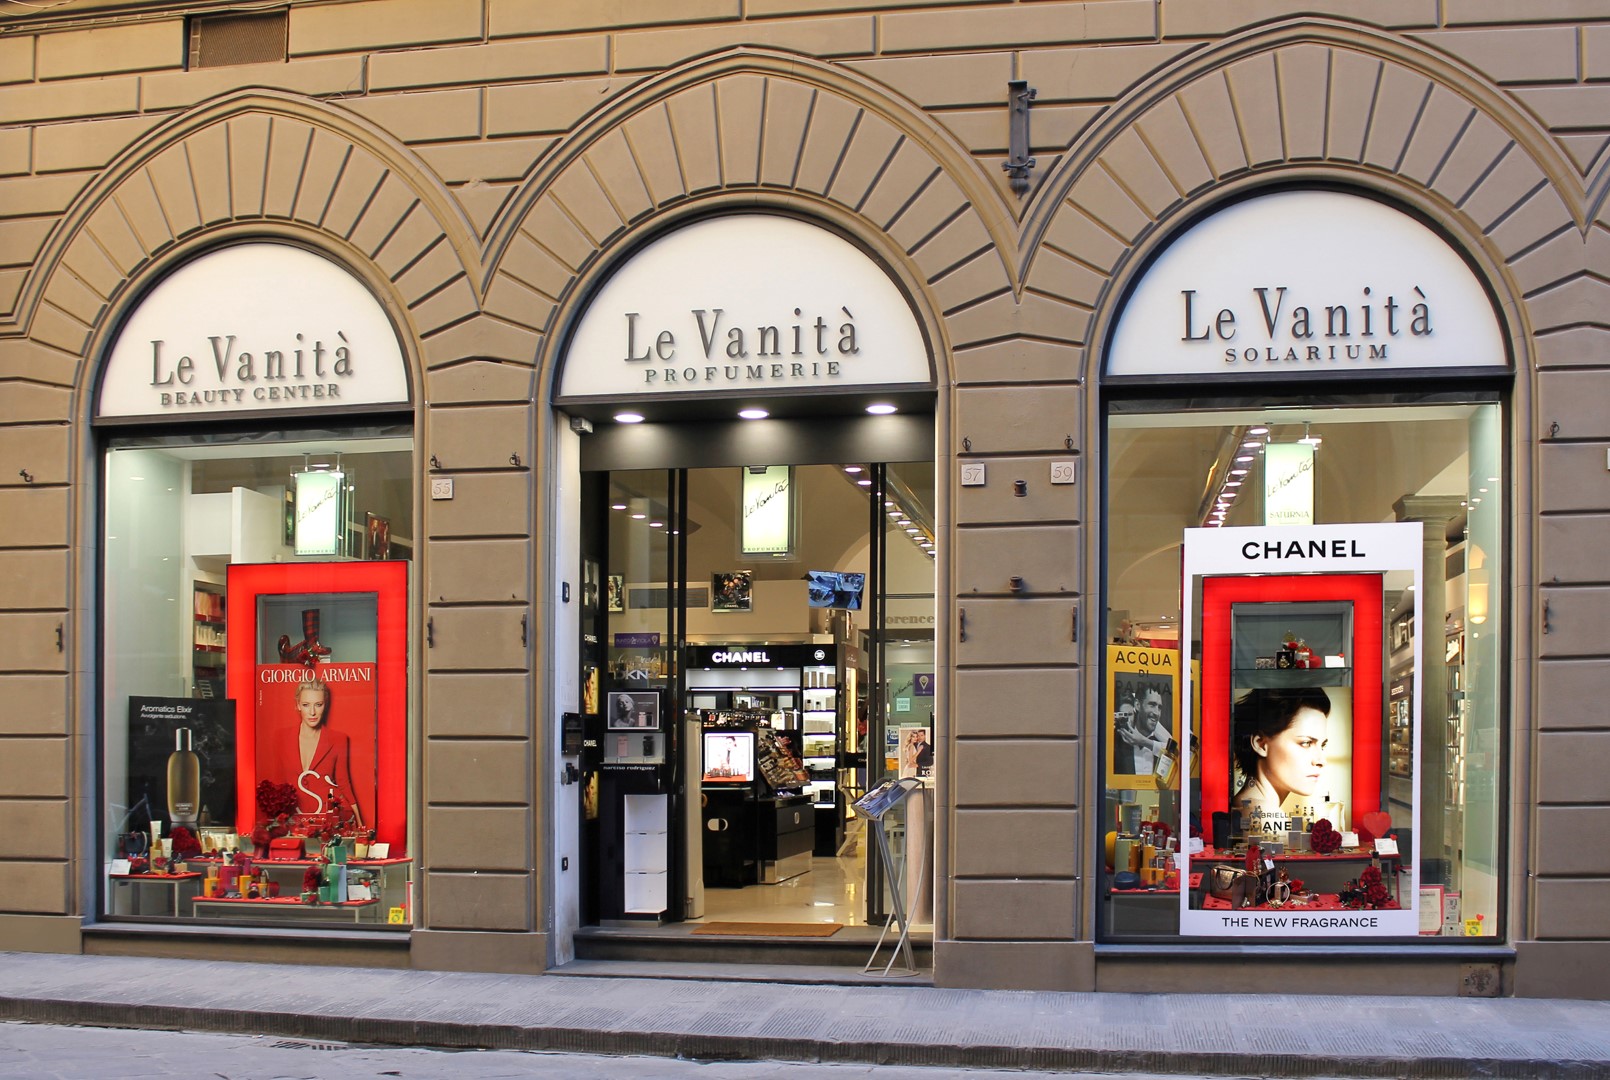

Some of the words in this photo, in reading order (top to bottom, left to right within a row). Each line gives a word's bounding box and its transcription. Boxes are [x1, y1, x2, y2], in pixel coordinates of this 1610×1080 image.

[1181, 290, 1236, 341] Le
[1253, 286, 1433, 339] Vanità
[624, 313, 675, 361] Le
[691, 306, 860, 359] Vanità
[150, 340, 194, 386] Le
[207, 331, 354, 383] Vanità
[1225, 344, 1388, 363] SOLARIUM
[644, 361, 841, 382] PROFUMERIE
[160, 388, 246, 406] BEAUTY
[253, 383, 341, 401] CENTER
[963, 467, 982, 481] 57
[1053, 466, 1072, 481] 59
[1242, 540, 1366, 560] CHANEL
[712, 651, 771, 663] CHANEL
[1115, 651, 1172, 666] ACQUA
[261, 668, 316, 683] GIORGIO
[320, 667, 371, 682] ARMANI
[1138, 669, 1149, 677] DI
[1116, 680, 1172, 695] PARMA
[140, 705, 176, 713] Aromatics
[1222, 917, 1249, 927] THE
[1254, 917, 1288, 927] NEW
[1292, 917, 1378, 928] FRAGRANCE
